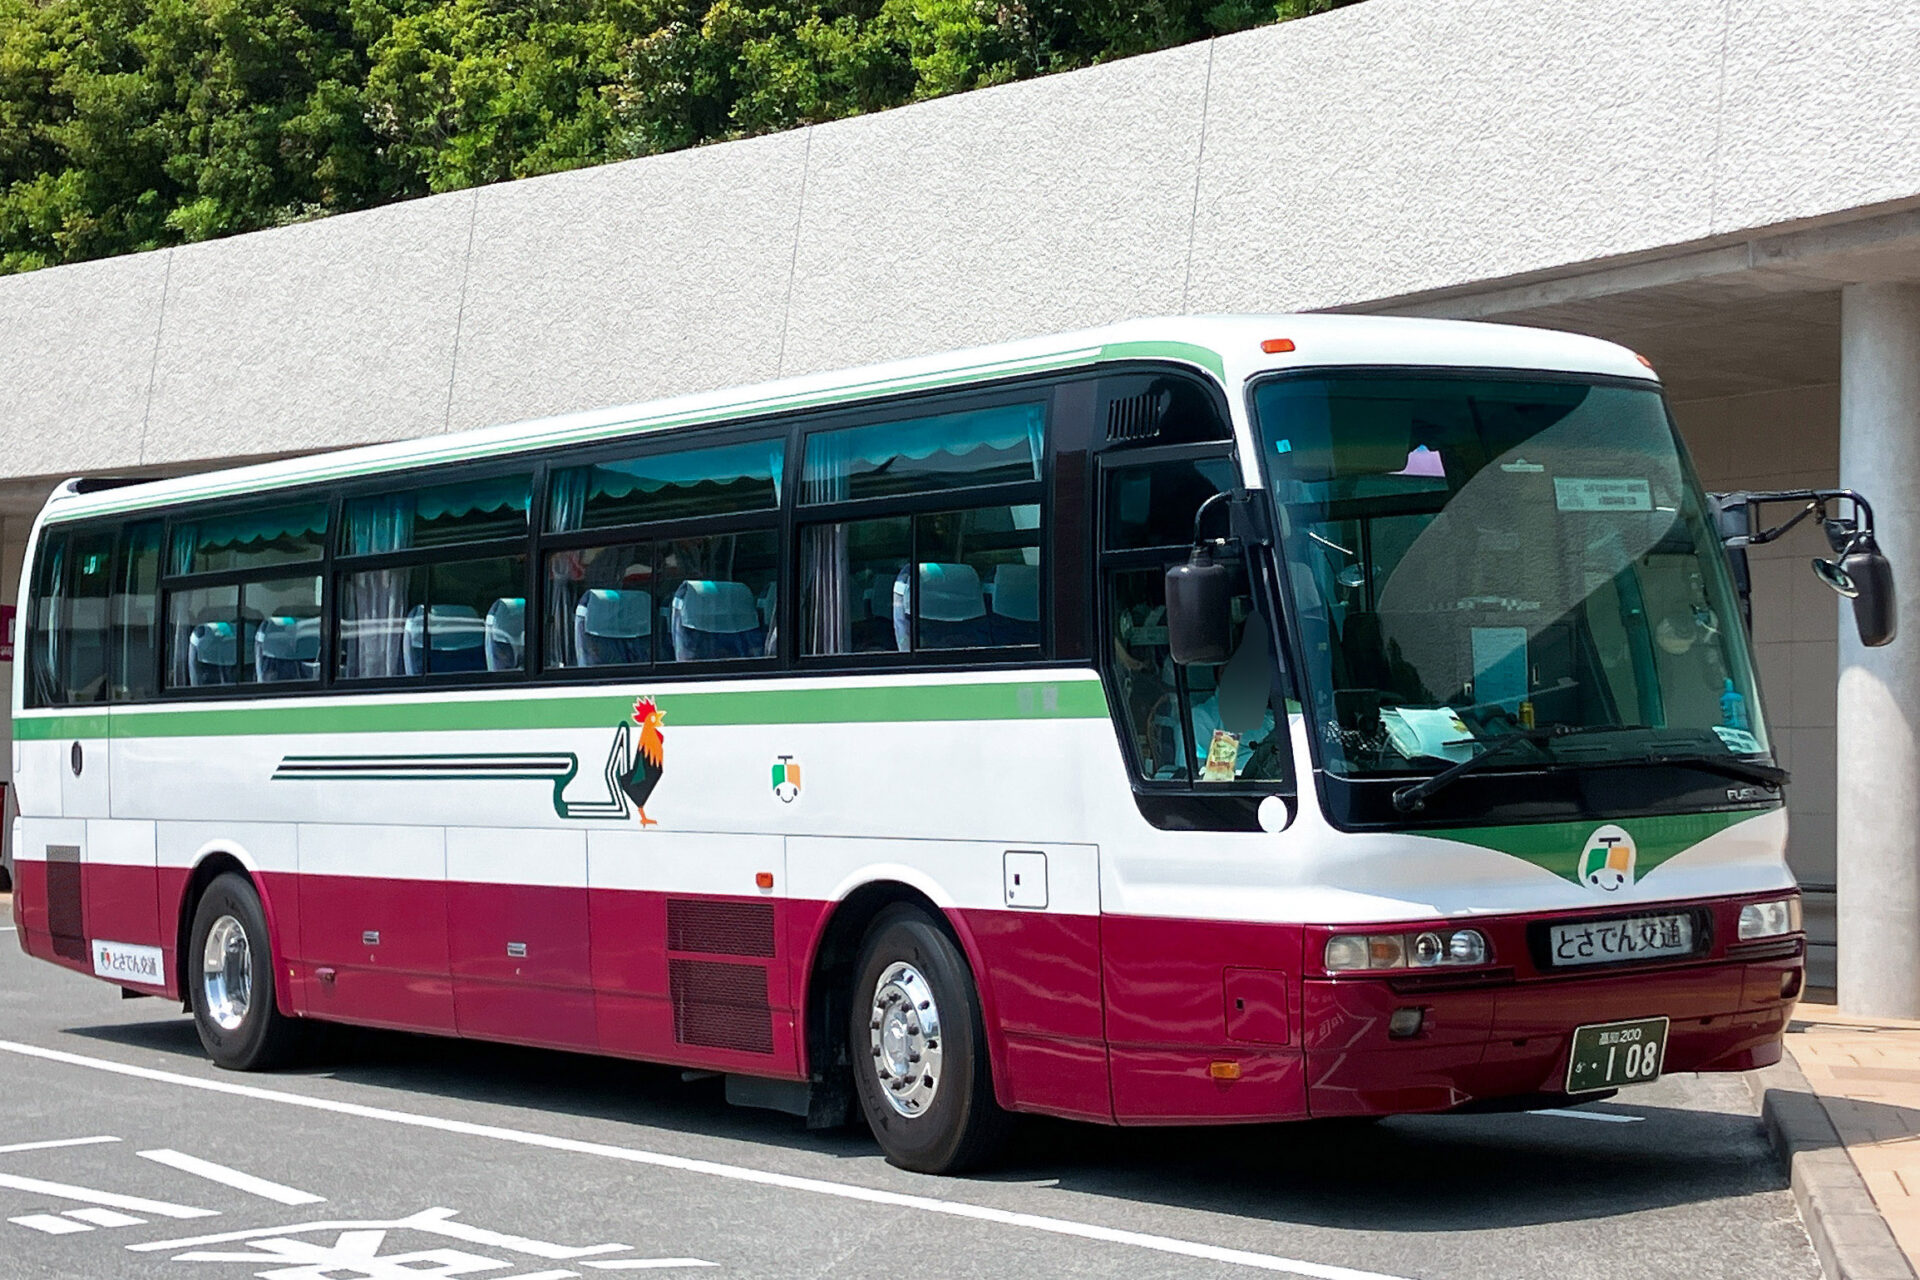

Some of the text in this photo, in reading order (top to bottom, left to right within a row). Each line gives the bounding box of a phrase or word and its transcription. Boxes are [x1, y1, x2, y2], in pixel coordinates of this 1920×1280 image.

[1557, 917, 1683, 959] とさでん交通
[112, 952, 157, 976] とさでん交通
